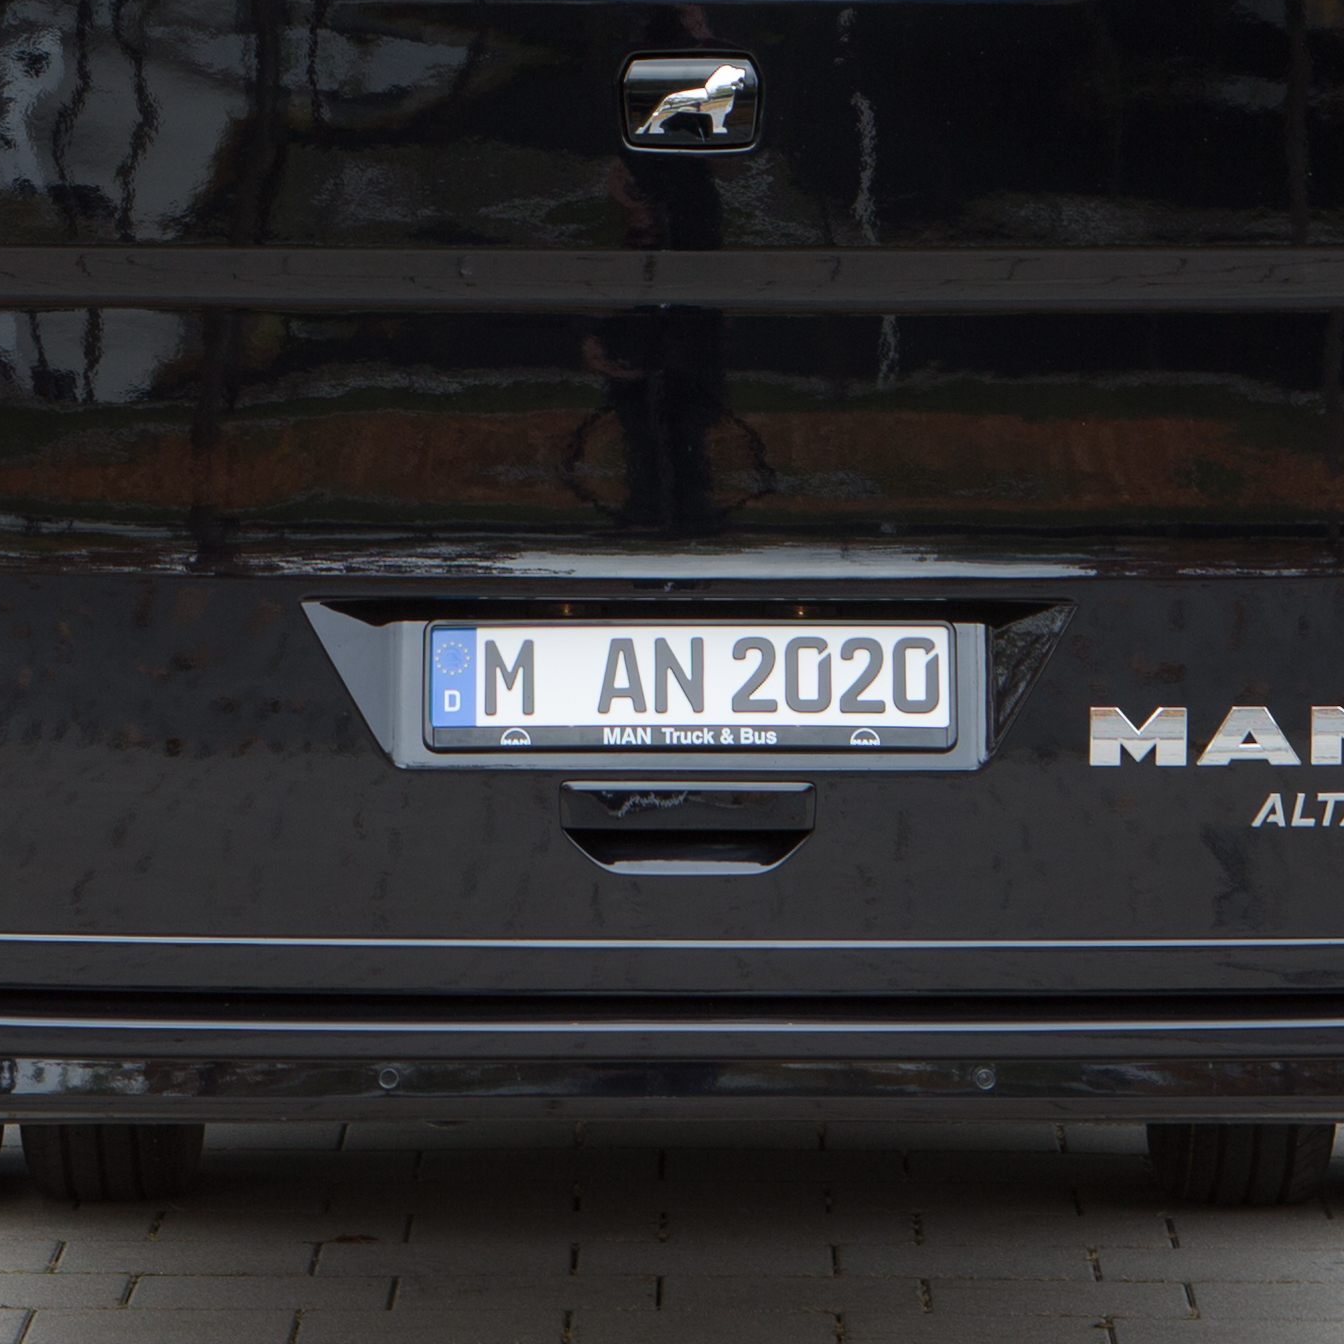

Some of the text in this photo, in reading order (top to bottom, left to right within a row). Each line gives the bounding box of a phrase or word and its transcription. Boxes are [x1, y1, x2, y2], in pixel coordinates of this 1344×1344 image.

[485, 637, 940, 716] M AN 2020
[444, 690, 461, 712] D
[602, 727, 778, 745] MAN Truck & Bus
